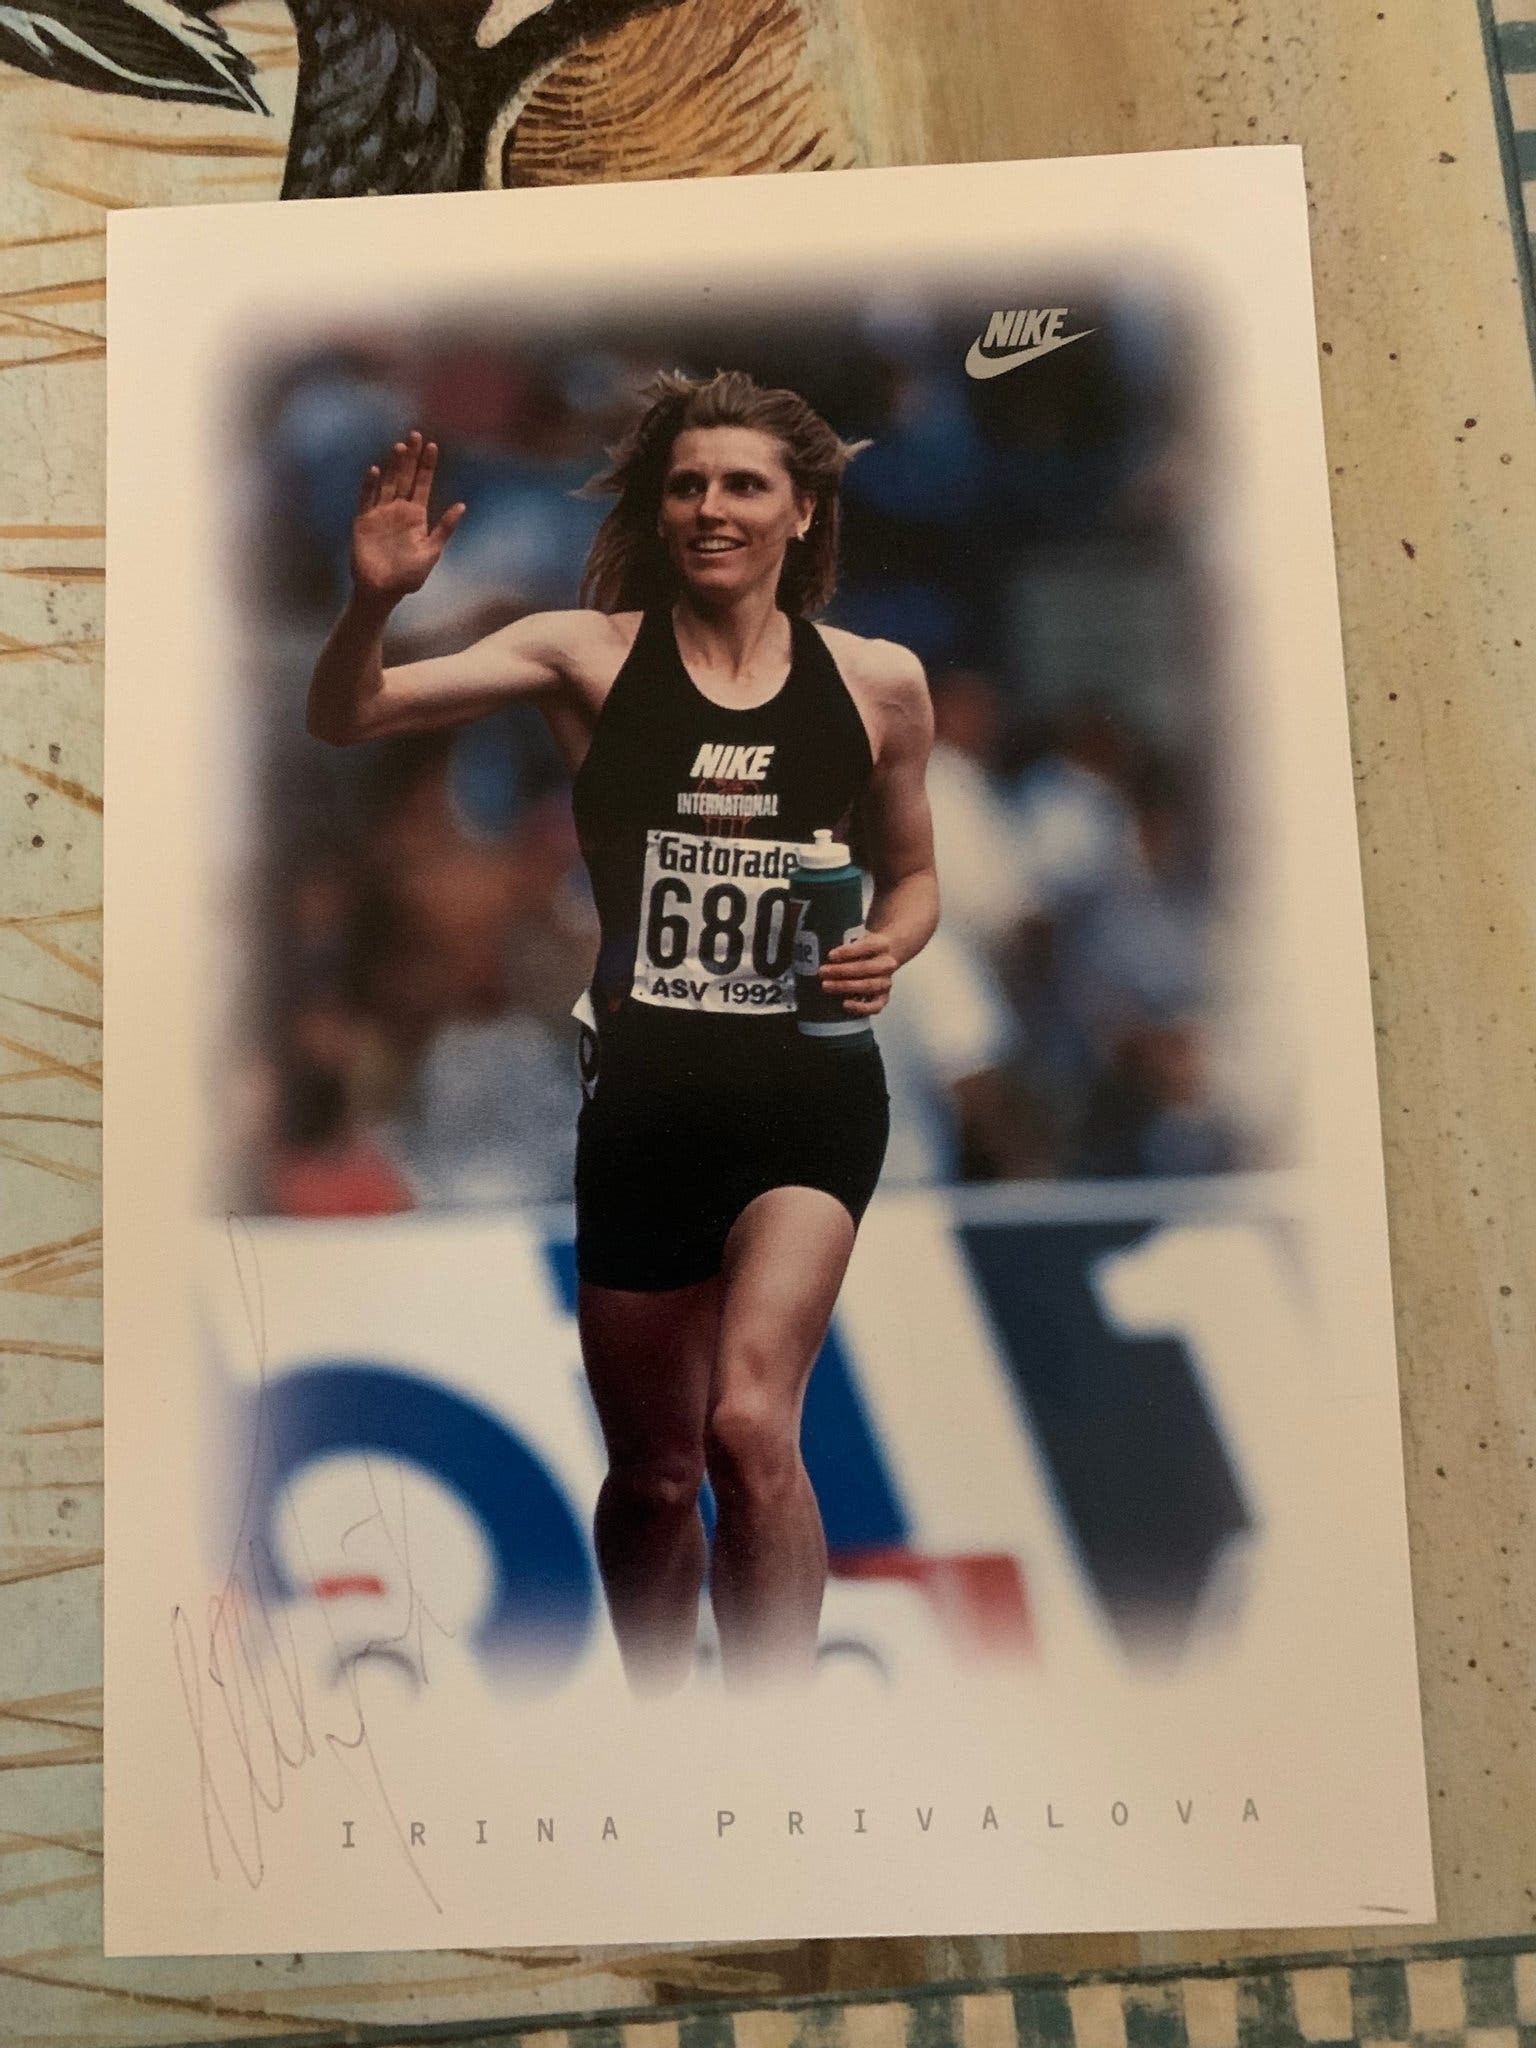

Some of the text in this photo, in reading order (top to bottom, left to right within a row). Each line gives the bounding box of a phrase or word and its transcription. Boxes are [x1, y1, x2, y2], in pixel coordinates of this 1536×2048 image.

[982, 308, 1068, 348] NIKE
[689, 743, 775, 780] NIKE
[677, 793, 778, 816] INTERNATIONAL
[659, 836, 799, 878] Gatorade
[646, 877, 796, 979] 680
[651, 976, 783, 1005] ASV 1992
[341, 1798, 1260, 1848] IRINA PRIVALOVA
